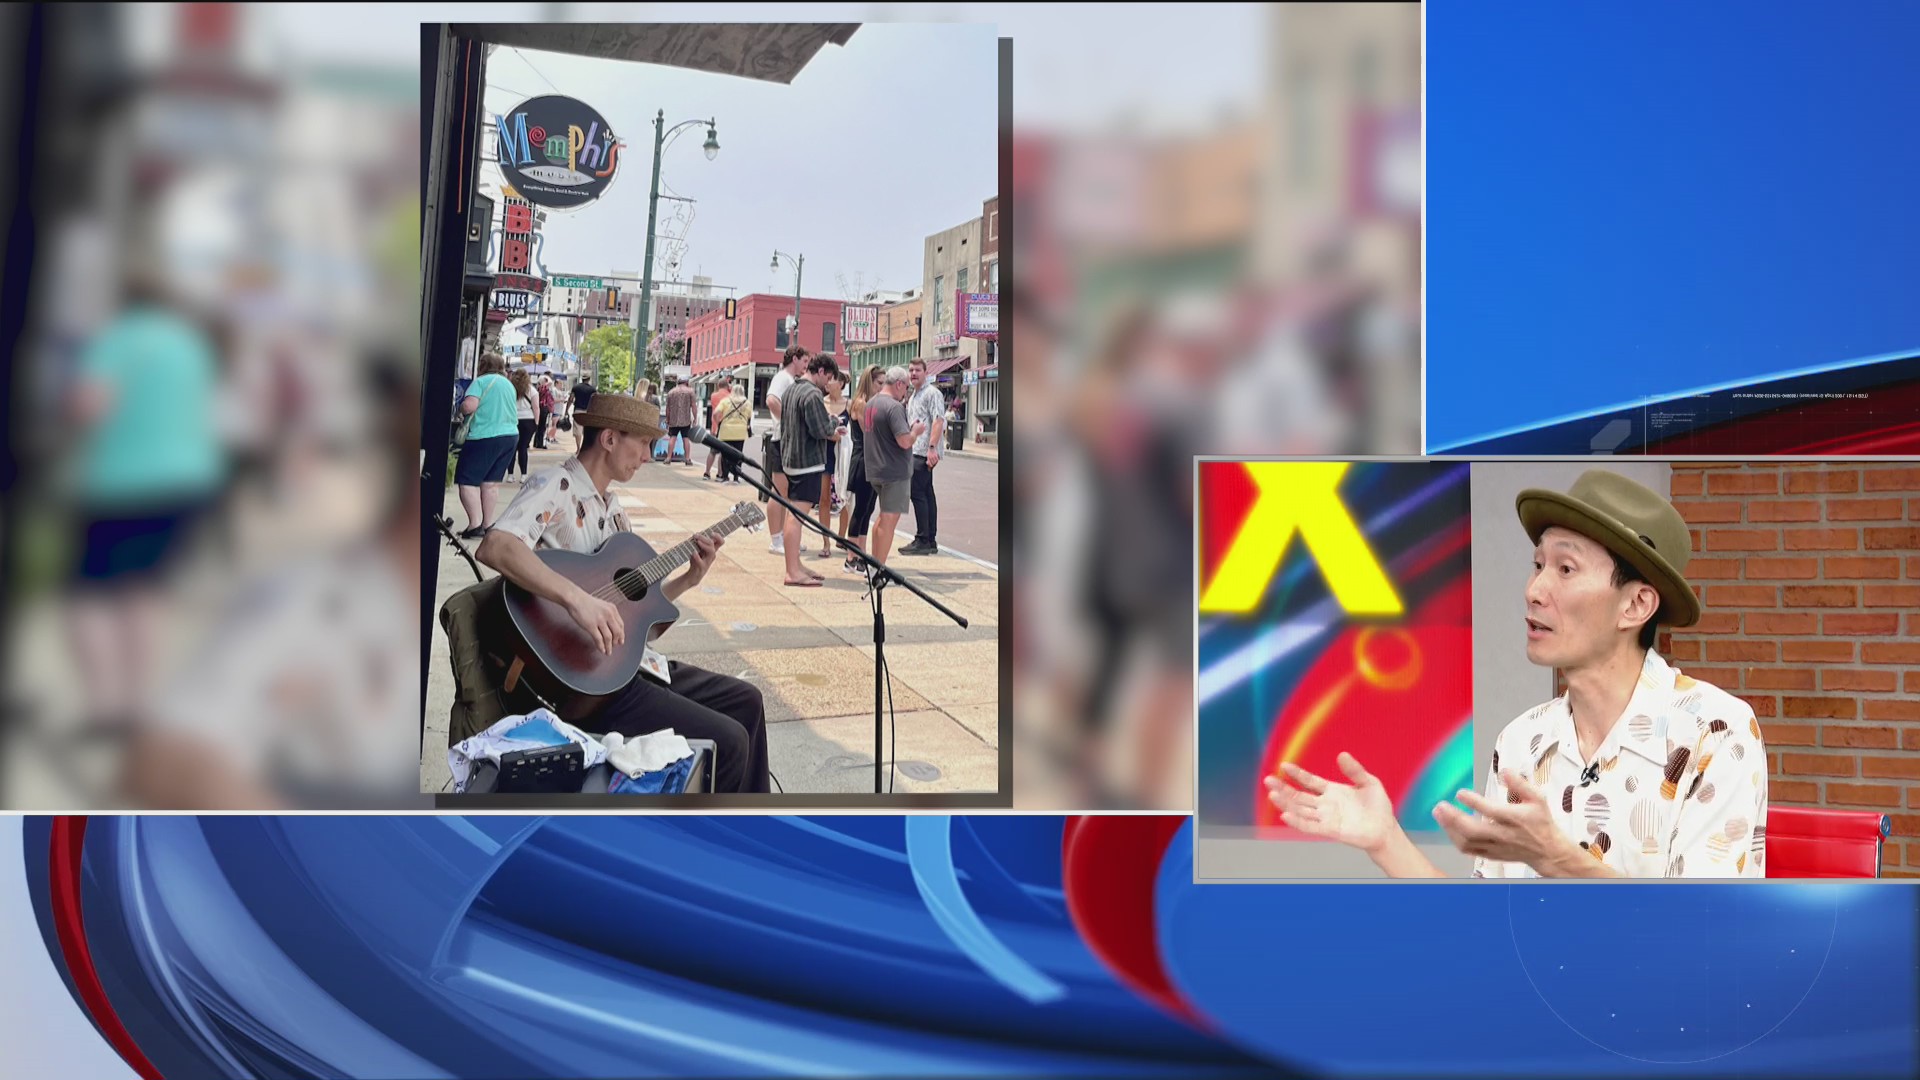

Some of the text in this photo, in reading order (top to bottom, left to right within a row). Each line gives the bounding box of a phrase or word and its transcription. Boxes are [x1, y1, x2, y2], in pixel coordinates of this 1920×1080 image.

[495, 112, 627, 178] Memphis
[563, 278, 589, 288] Second
[590, 279, 599, 288] St
[498, 293, 527, 308] BLUES
[848, 308, 875, 321] BLUES
[848, 321, 875, 340] CAFE
